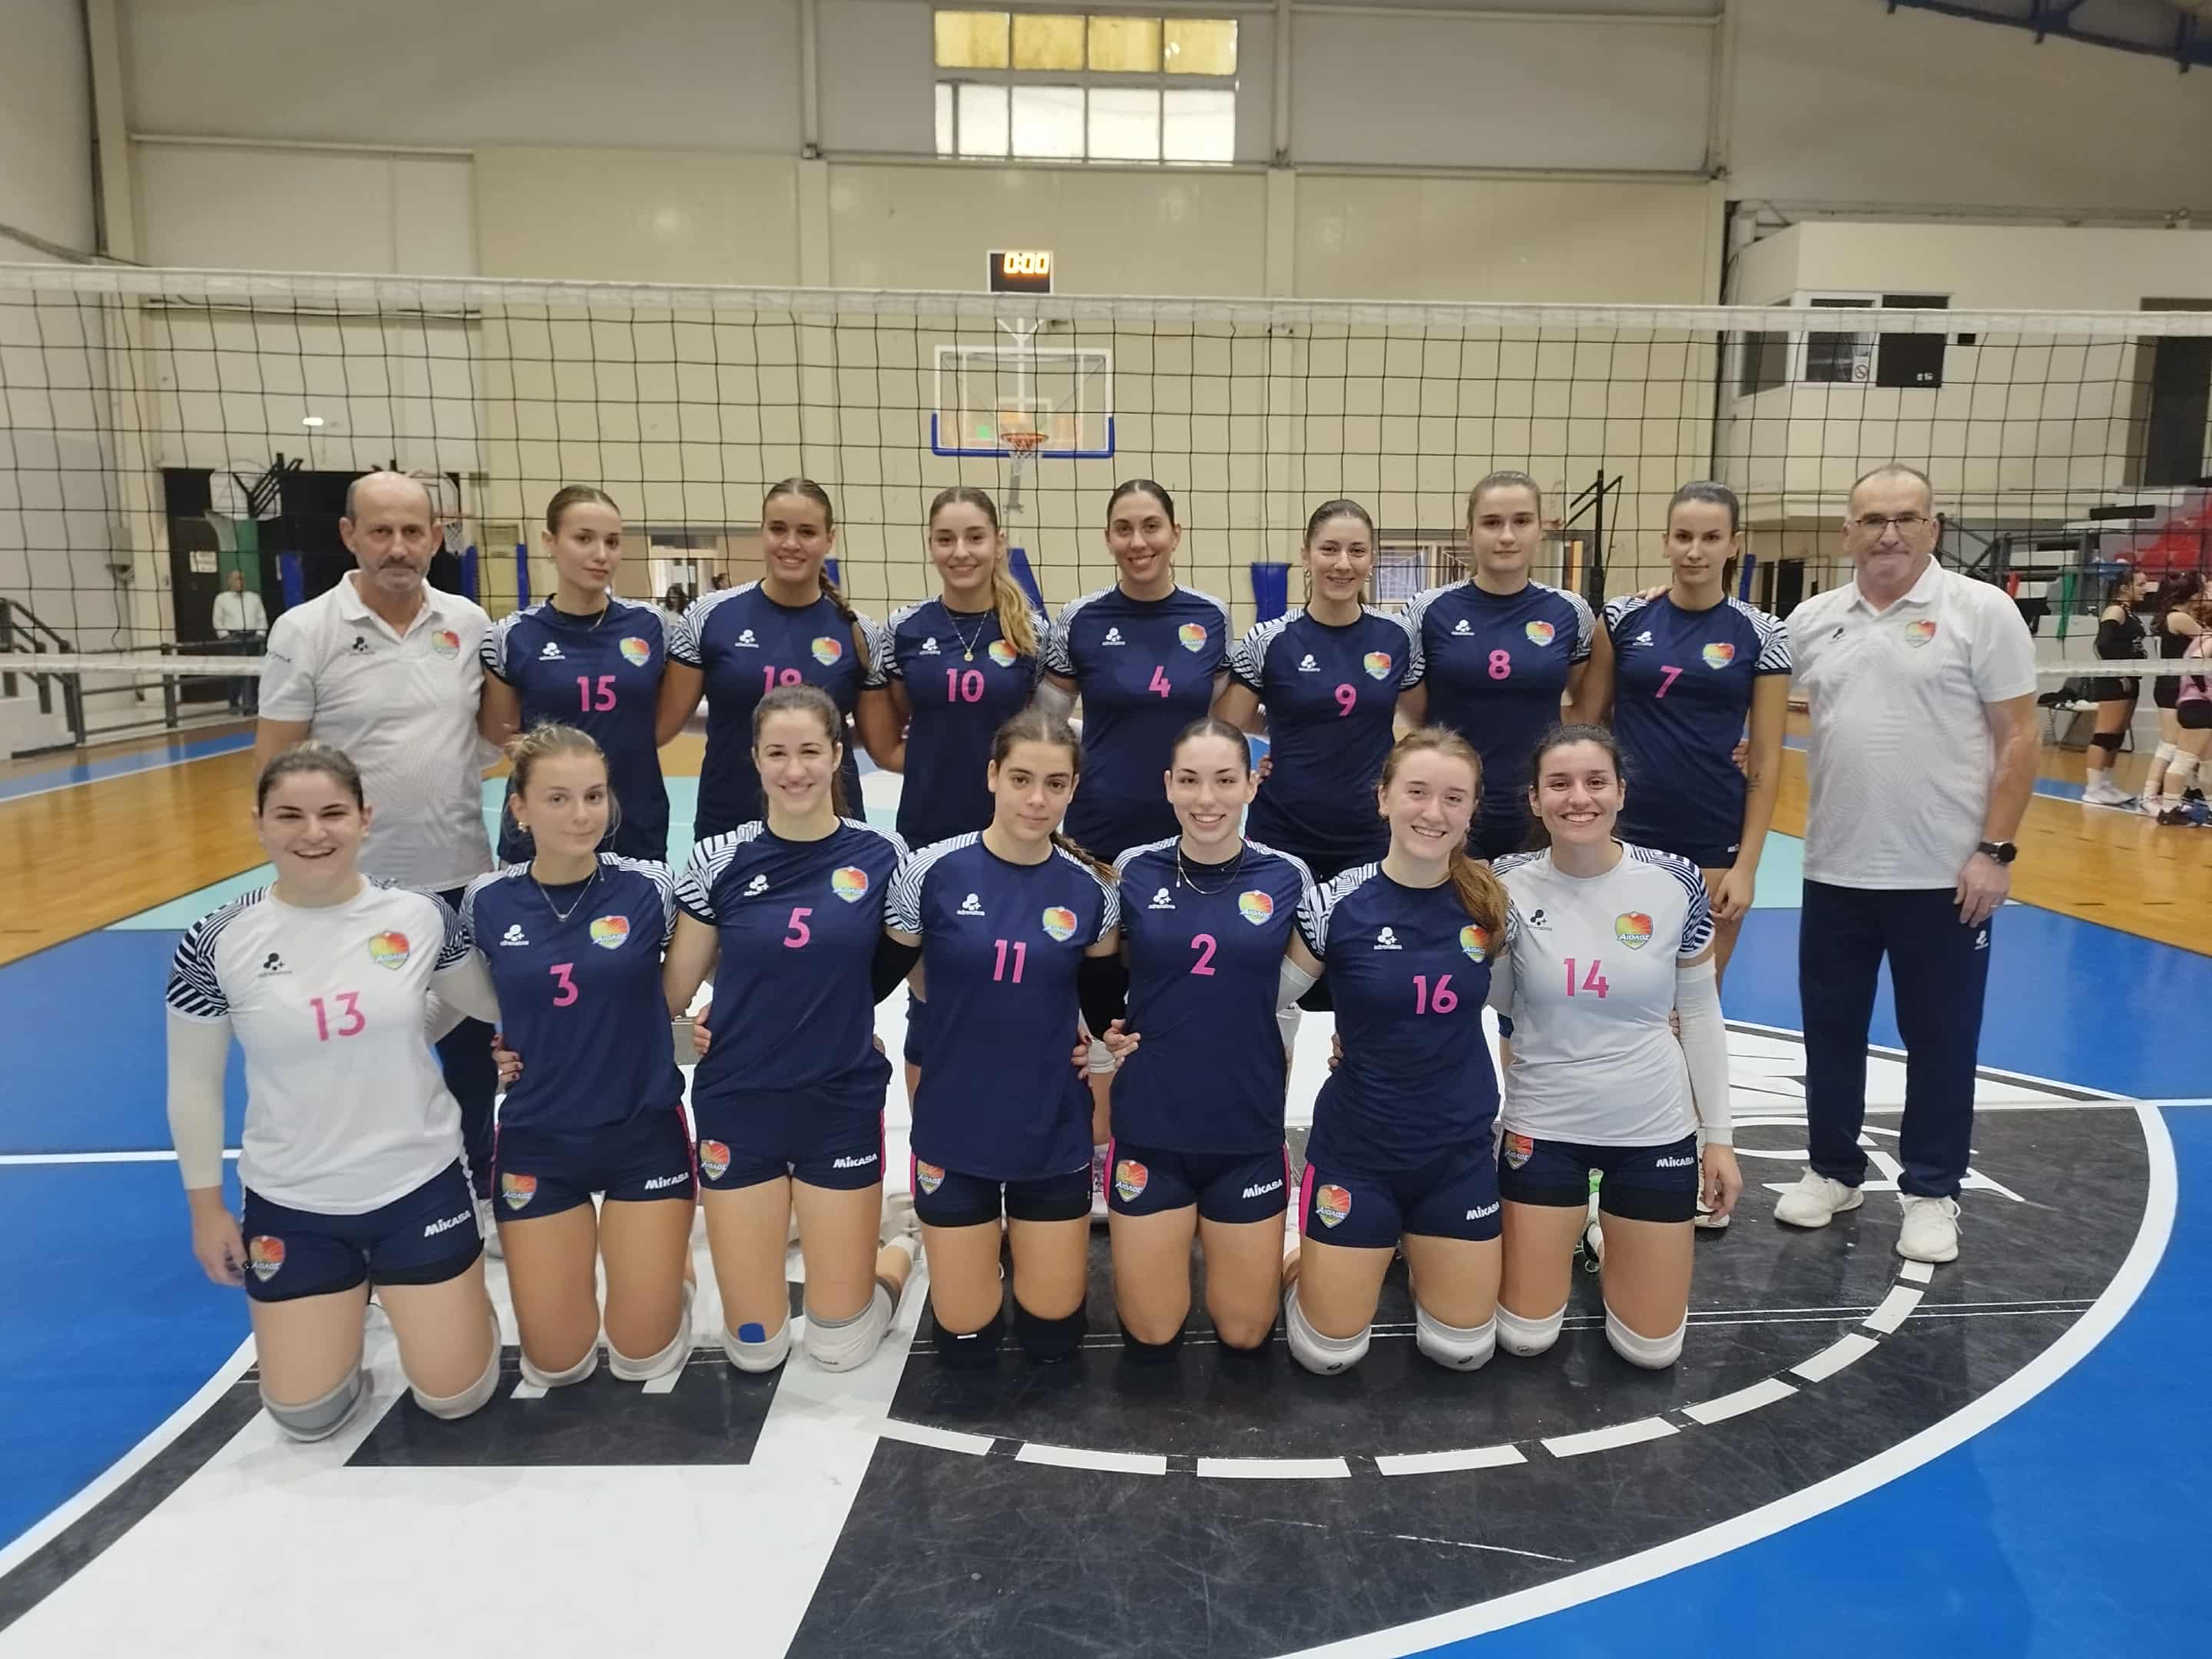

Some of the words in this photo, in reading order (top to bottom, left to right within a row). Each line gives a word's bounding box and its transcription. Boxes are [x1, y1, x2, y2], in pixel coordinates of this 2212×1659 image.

[1003, 252, 1050, 274] 0:00
[1148, 665, 1171, 698] 4
[1488, 649, 1512, 680] 8
[1654, 665, 1684, 698] 7
[577, 675, 618, 712] 15
[946, 668, 985, 703] 10
[1334, 683, 1357, 717] 9
[783, 907, 813, 949] 5
[993, 939, 1027, 984] 11
[1190, 933, 1217, 976] 2
[549, 962, 578, 1007] 3
[1413, 974, 1458, 1015] 16
[1562, 958, 1609, 999] 14
[310, 991, 366, 1041] 13
